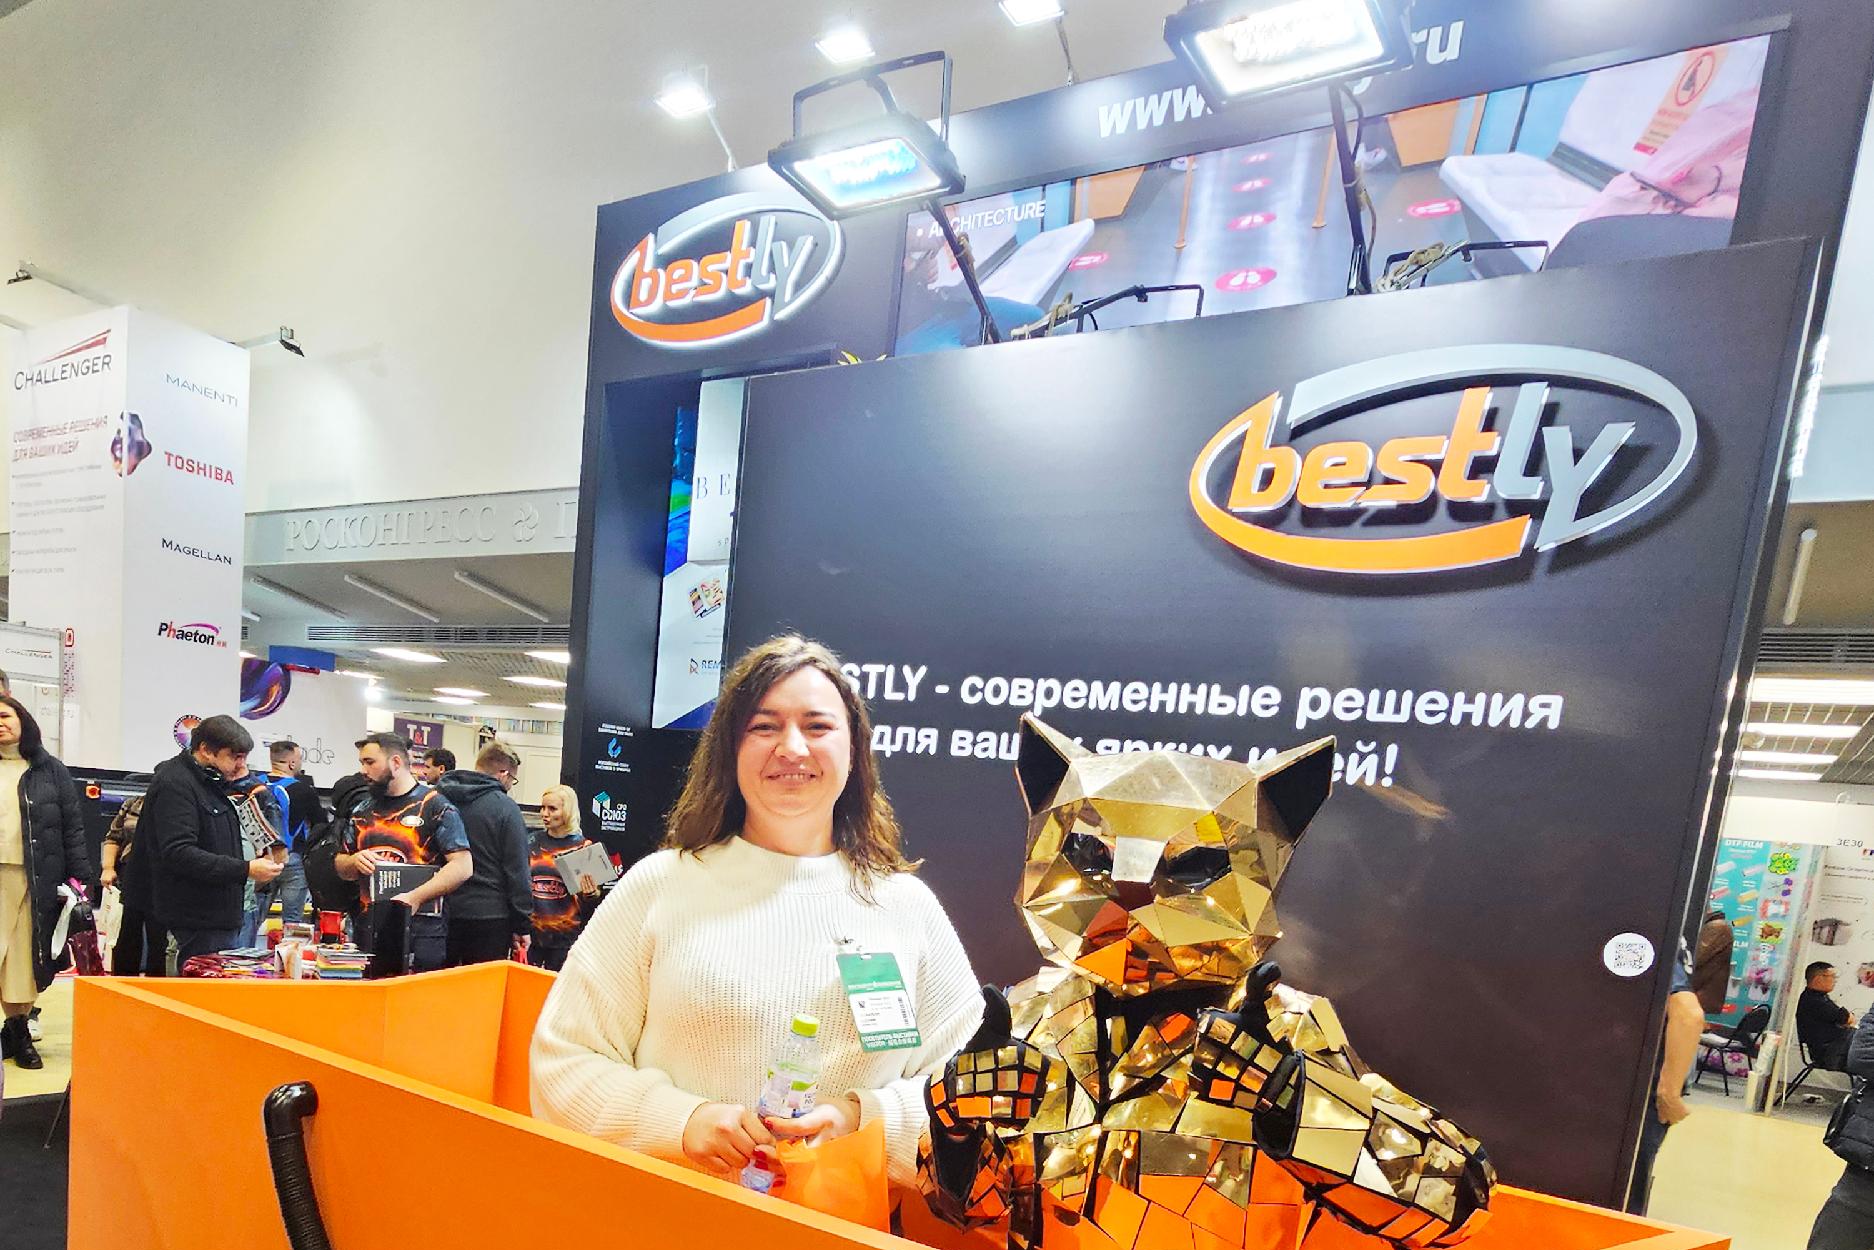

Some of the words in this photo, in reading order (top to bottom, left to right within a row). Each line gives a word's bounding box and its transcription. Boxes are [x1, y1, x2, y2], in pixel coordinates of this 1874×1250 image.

[928, 200, 1046, 238] ACHITECTURE
[624, 212, 818, 321] bestly
[14, 354, 112, 391] CHALLENGER
[165, 373, 239, 407] MANENTI
[164, 451, 235, 485] TOSHIBA
[1222, 378, 1640, 553] bestly
[161, 537, 233, 566] MAGELLAN
[157, 621, 215, 646] Phaeton
[960, 676, 1283, 718] современные
[1295, 686, 1565, 730] решения
[870, 724, 939, 758] для
